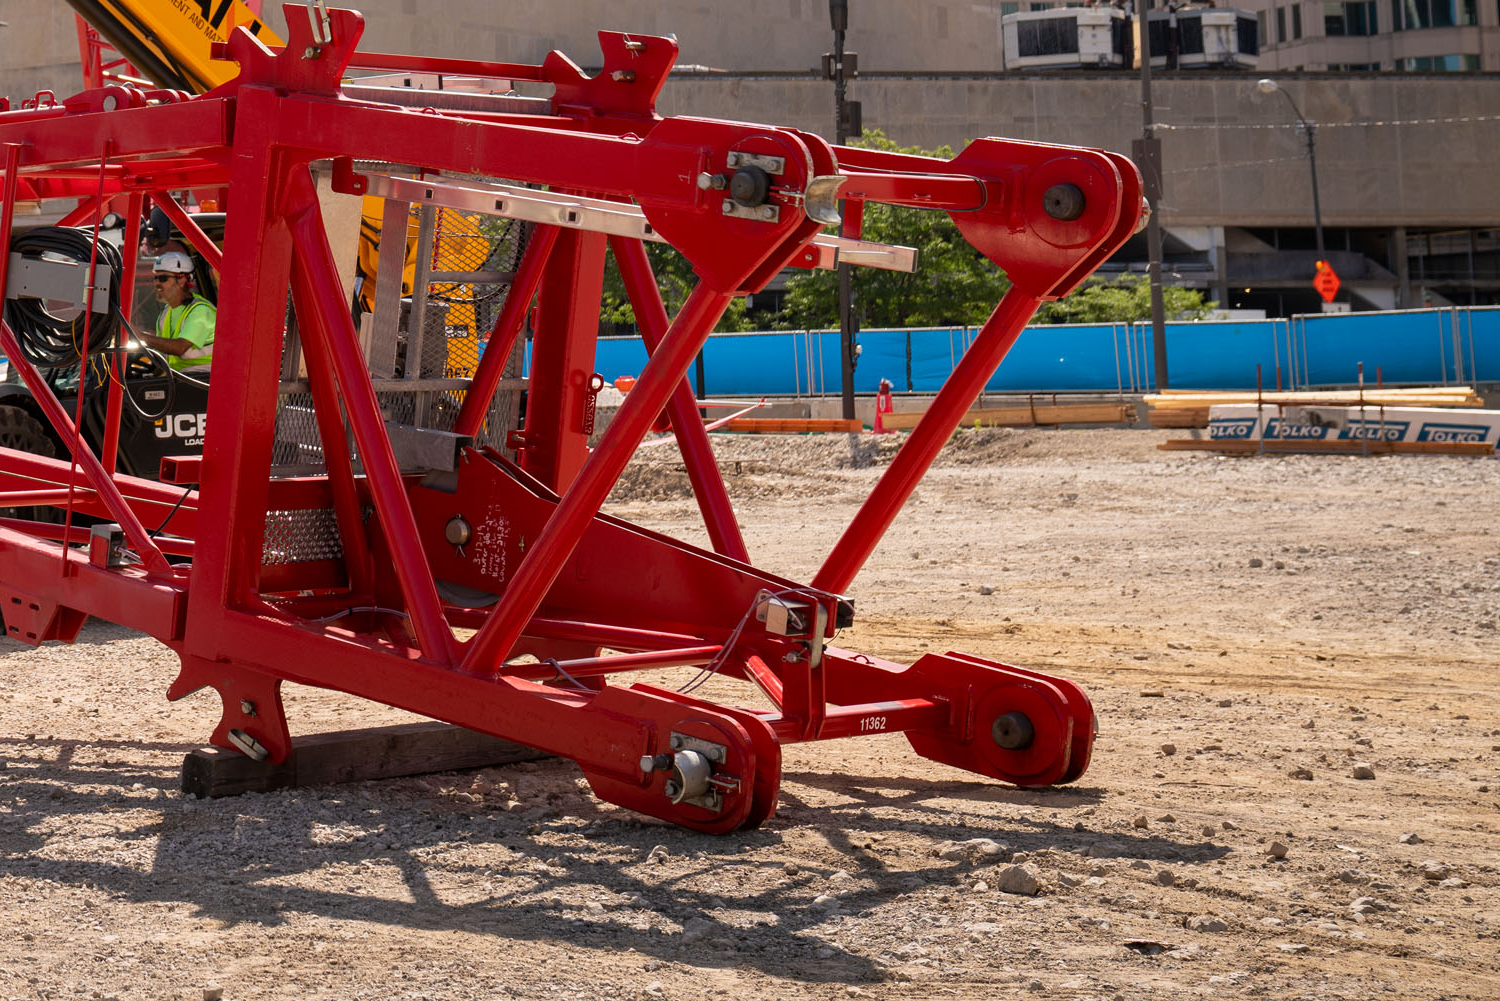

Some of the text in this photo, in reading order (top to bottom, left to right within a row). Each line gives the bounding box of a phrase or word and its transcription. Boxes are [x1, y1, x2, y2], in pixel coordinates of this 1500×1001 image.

[188, 12, 205, 31] AND
[1269, 421, 1323, 437] TOLKO
[1424, 427, 1486, 442] TOLKO
[860, 716, 887, 731] 11362
